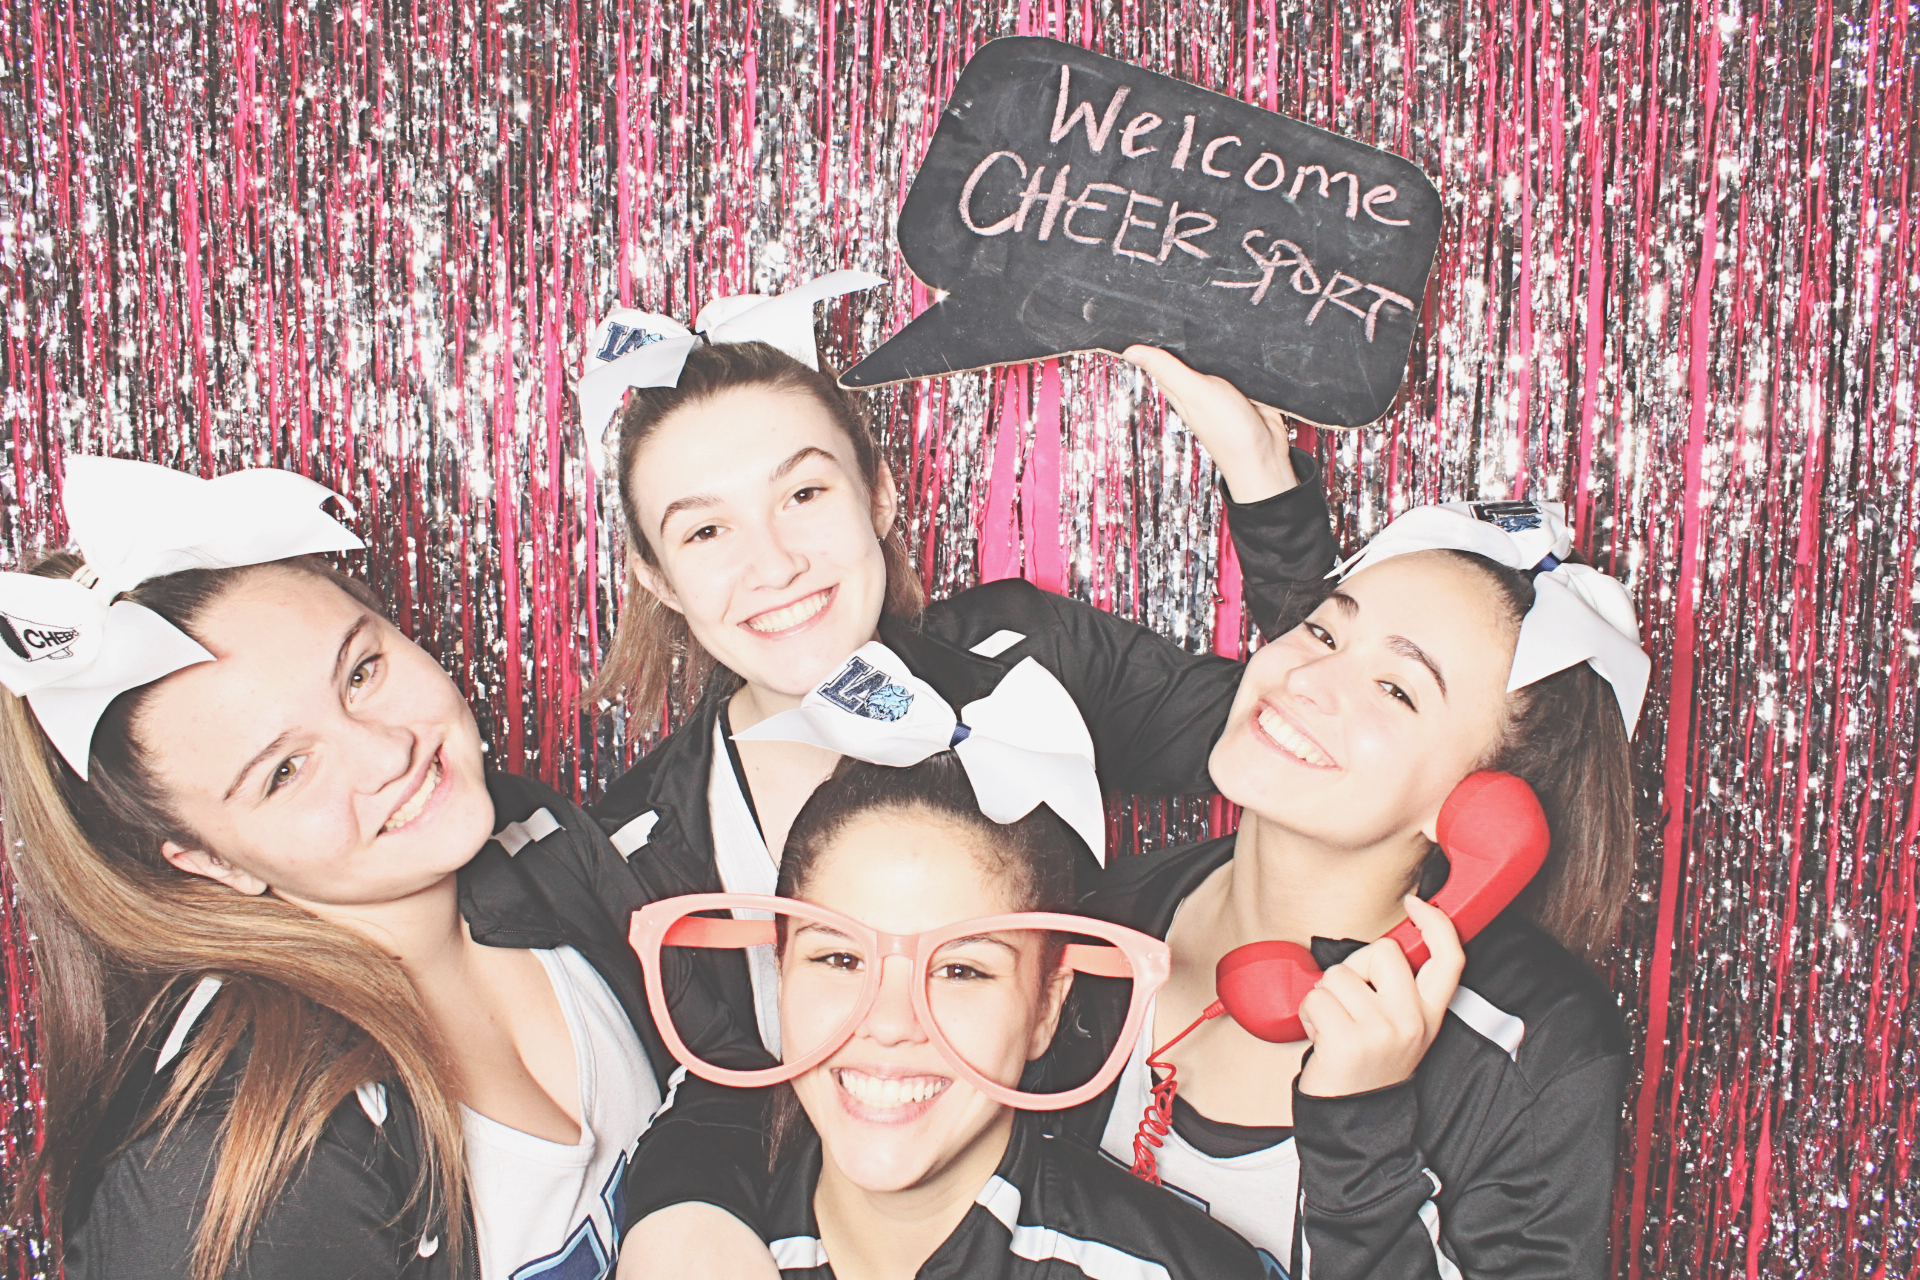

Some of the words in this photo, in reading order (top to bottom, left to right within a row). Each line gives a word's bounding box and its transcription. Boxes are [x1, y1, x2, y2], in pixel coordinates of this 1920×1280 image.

[1050, 64, 1410, 226] Welcome
[960, 151, 1217, 264] CHEER
[1211, 229, 1415, 343] SPORT
